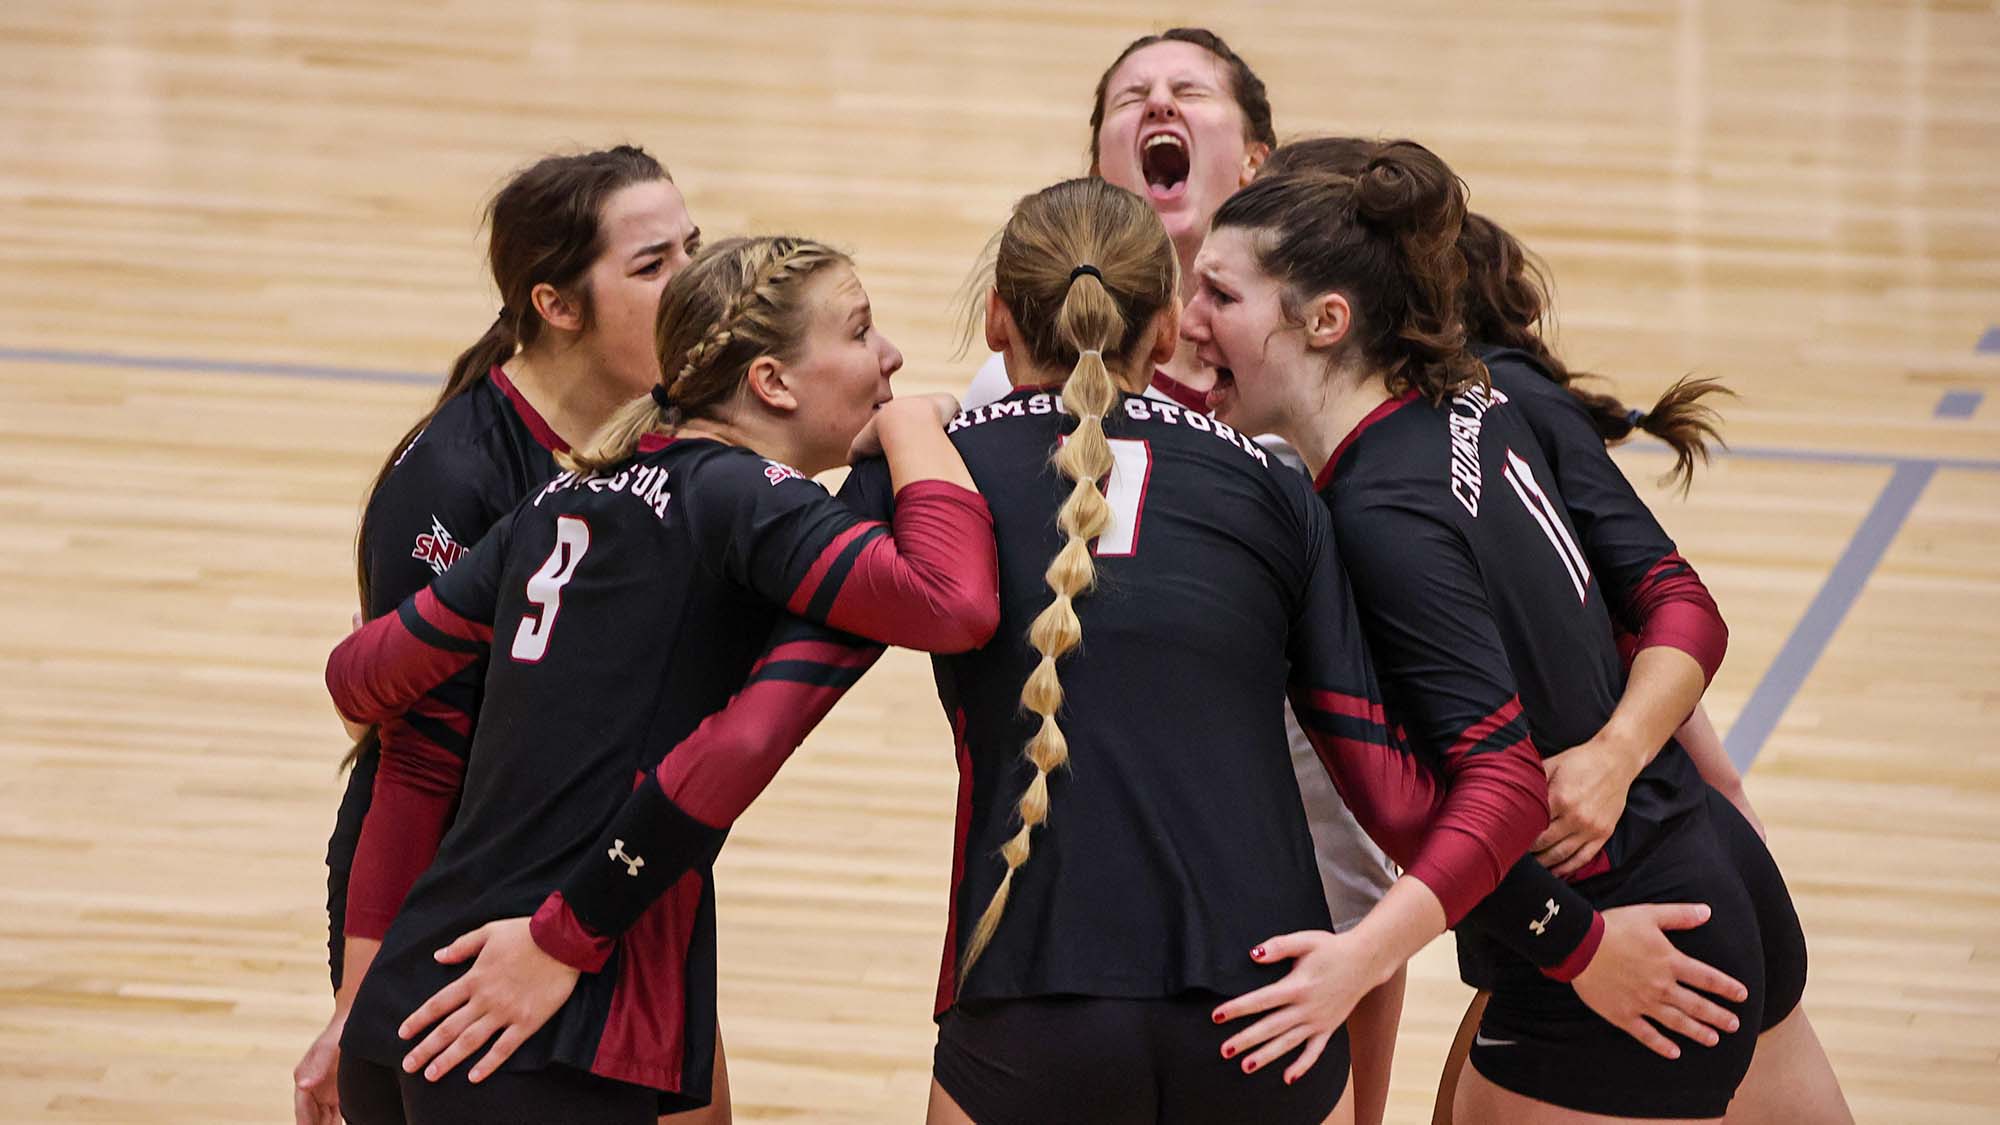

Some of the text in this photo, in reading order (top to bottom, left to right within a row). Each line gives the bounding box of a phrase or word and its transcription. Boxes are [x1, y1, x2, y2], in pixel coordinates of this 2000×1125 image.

[1124, 397, 1269, 469] STORM
[510, 513, 592, 665] 9
[1501, 445, 1592, 608] 11
